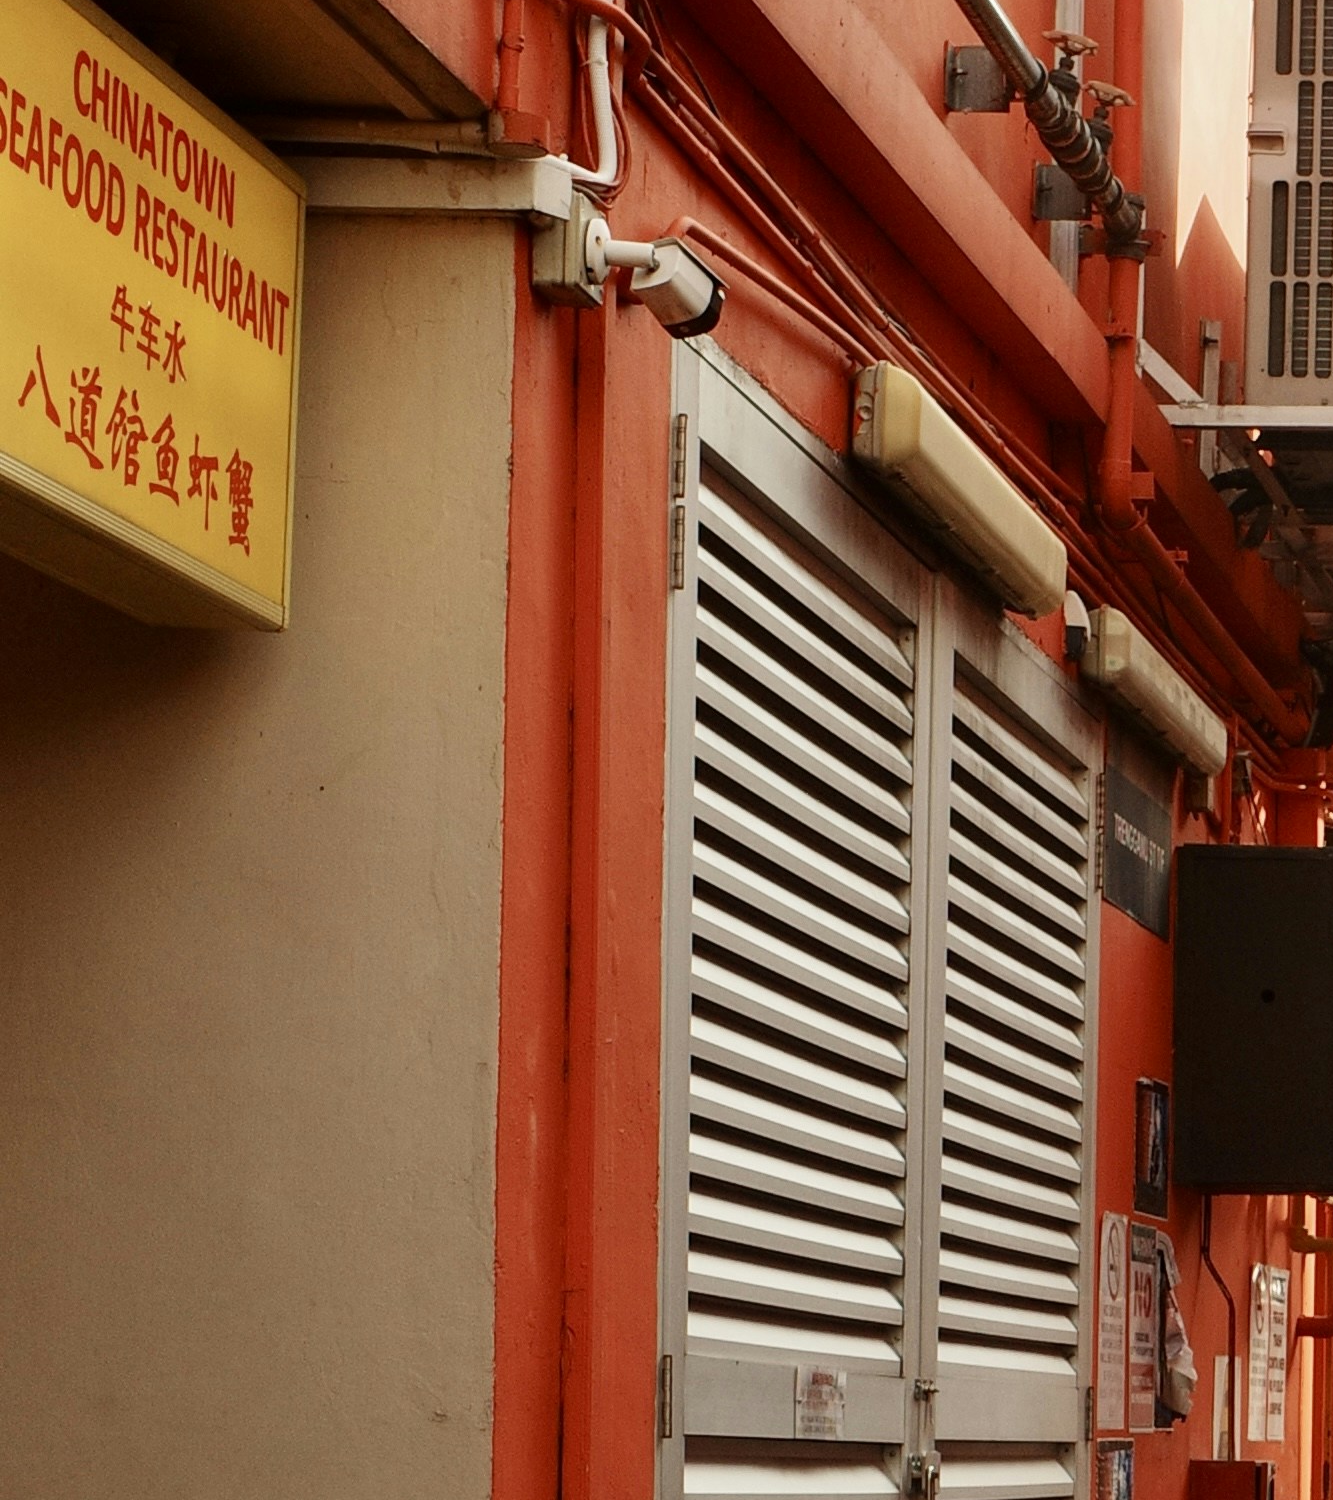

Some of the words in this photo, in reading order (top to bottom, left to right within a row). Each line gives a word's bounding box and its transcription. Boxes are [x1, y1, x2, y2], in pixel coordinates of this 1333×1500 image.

[73, 50, 235, 228] CHINATOWN
[110, 284, 187, 383] 牛车水
[134, 183, 290, 356] RESTAURANT
[18, 344, 254, 557] 八道馆鱼虾蟹
